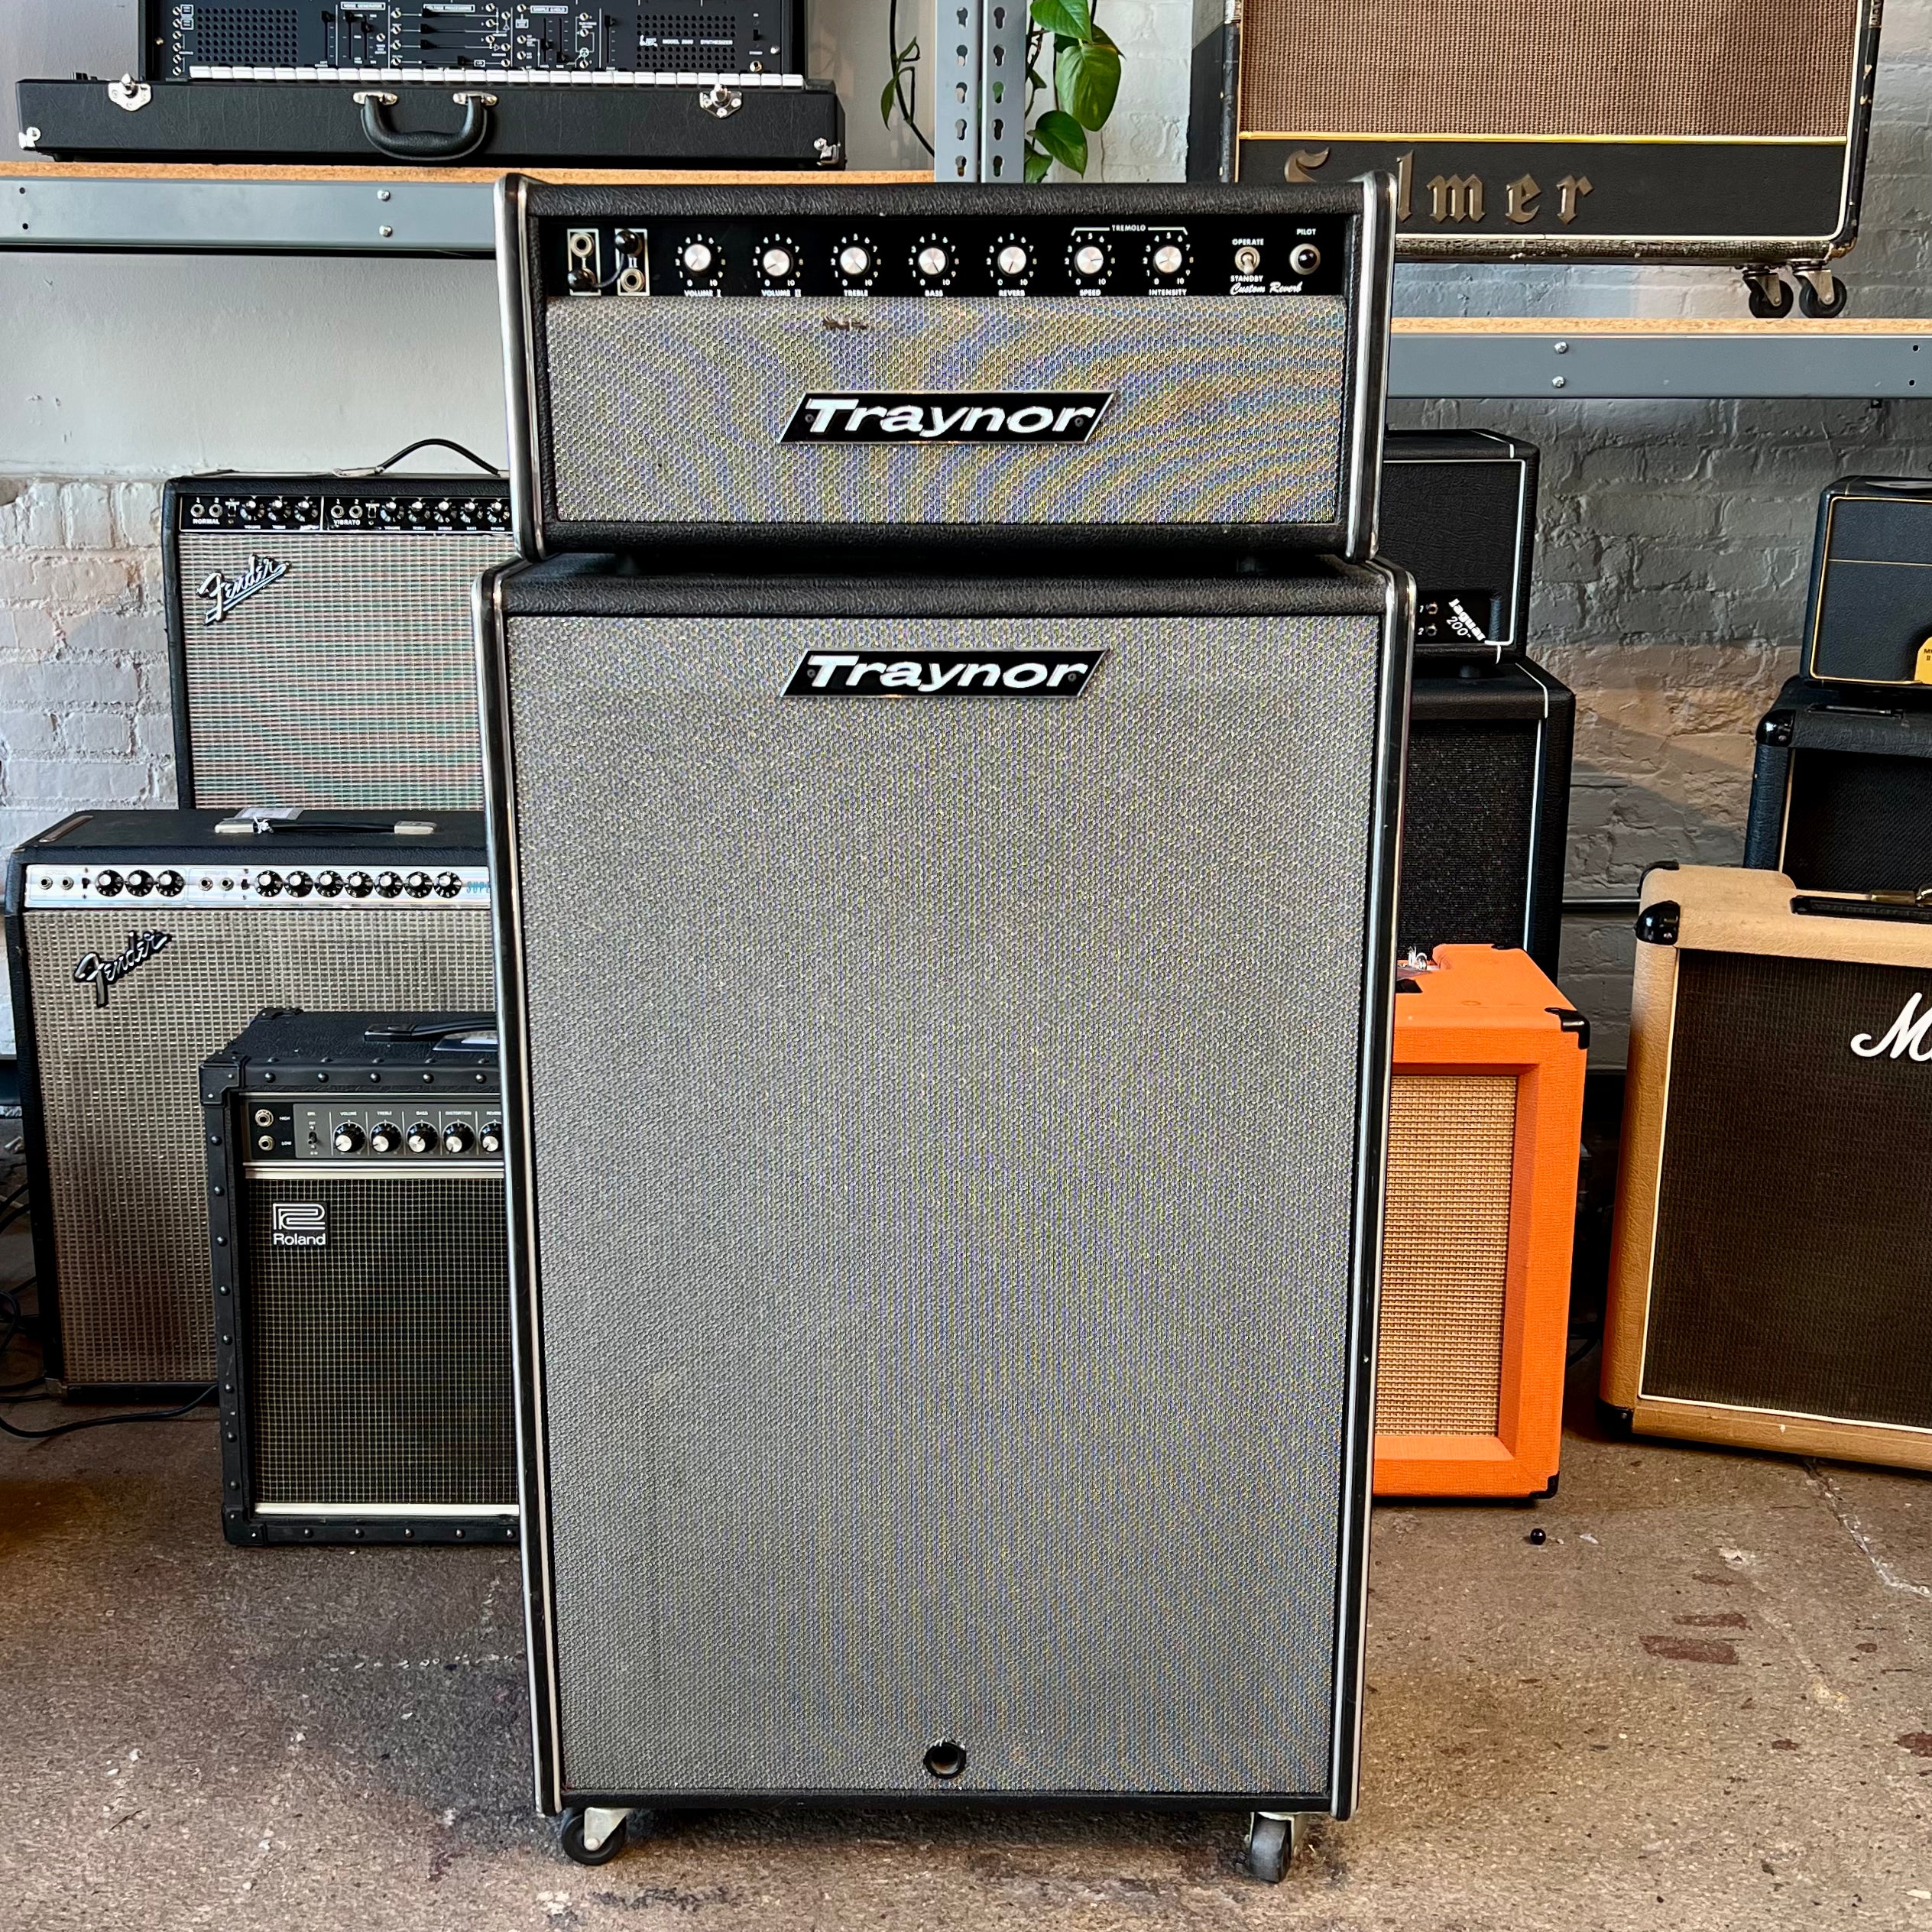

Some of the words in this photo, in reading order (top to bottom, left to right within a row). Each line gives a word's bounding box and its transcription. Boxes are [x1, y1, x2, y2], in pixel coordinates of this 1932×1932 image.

[1285, 147, 1594, 225] lmer
[685, 236, 692, 245] 4
[864, 236, 870, 245] 6
[919, 235, 925, 244] 4
[997, 235, 1003, 244] 4
[1154, 235, 1160, 243] 4
[1177, 235, 1183, 243] 6
[1231, 238, 1265, 246] OPERATE
[677, 246, 683, 254] 3
[752, 258, 758, 267] 2
[755, 246, 761, 254] 3
[763, 236, 769, 245] 4
[832, 245, 839, 254] 3
[910, 245, 917, 254] 3
[951, 245, 956, 253] 7
[989, 245, 995, 254] 3
[1029, 245, 1034, 253] 7
[1067, 245, 1073, 253] 3
[1145, 245, 1152, 253] 3
[675, 258, 681, 267] 2
[830, 258, 836, 266] 2
[908, 258, 914, 266] 2
[986, 257, 992, 265] 2
[1064, 257, 1070, 265] 2
[1143, 256, 1149, 264] 2
[686, 279, 693, 287] 0
[841, 278, 848, 287] 0
[919, 278, 926, 287] 0
[997, 278, 1003, 287] 0
[1019, 278, 1029, 287] 10
[1075, 277, 1081, 286] 0
[1098, 277, 1107, 286] 10
[1176, 277, 1185, 285] 10
[1230, 274, 1264, 283] STANDBY
[1079, 288, 1102, 297] SPEED
[1148, 288, 1188, 297] INTENSITY
[1230, 282, 1266, 296] Custom
[1269, 280, 1304, 293] Reverb
[683, 289, 714, 297] VOLUME
[760, 289, 792, 297] VOLUME
[843, 289, 869, 297] TREBLE
[924, 289, 944, 297] BASS
[998, 289, 1026, 297] REVERB
[805, 398, 1096, 438] Traynor
[196, 553, 292, 626] Fender
[1418, 605, 1425, 614] 1
[1417, 627, 1425, 636] 2
[806, 654, 1089, 692] Traynor
[75, 930, 173, 1008] Fender
[273, 1233, 326, 1246] Roland
